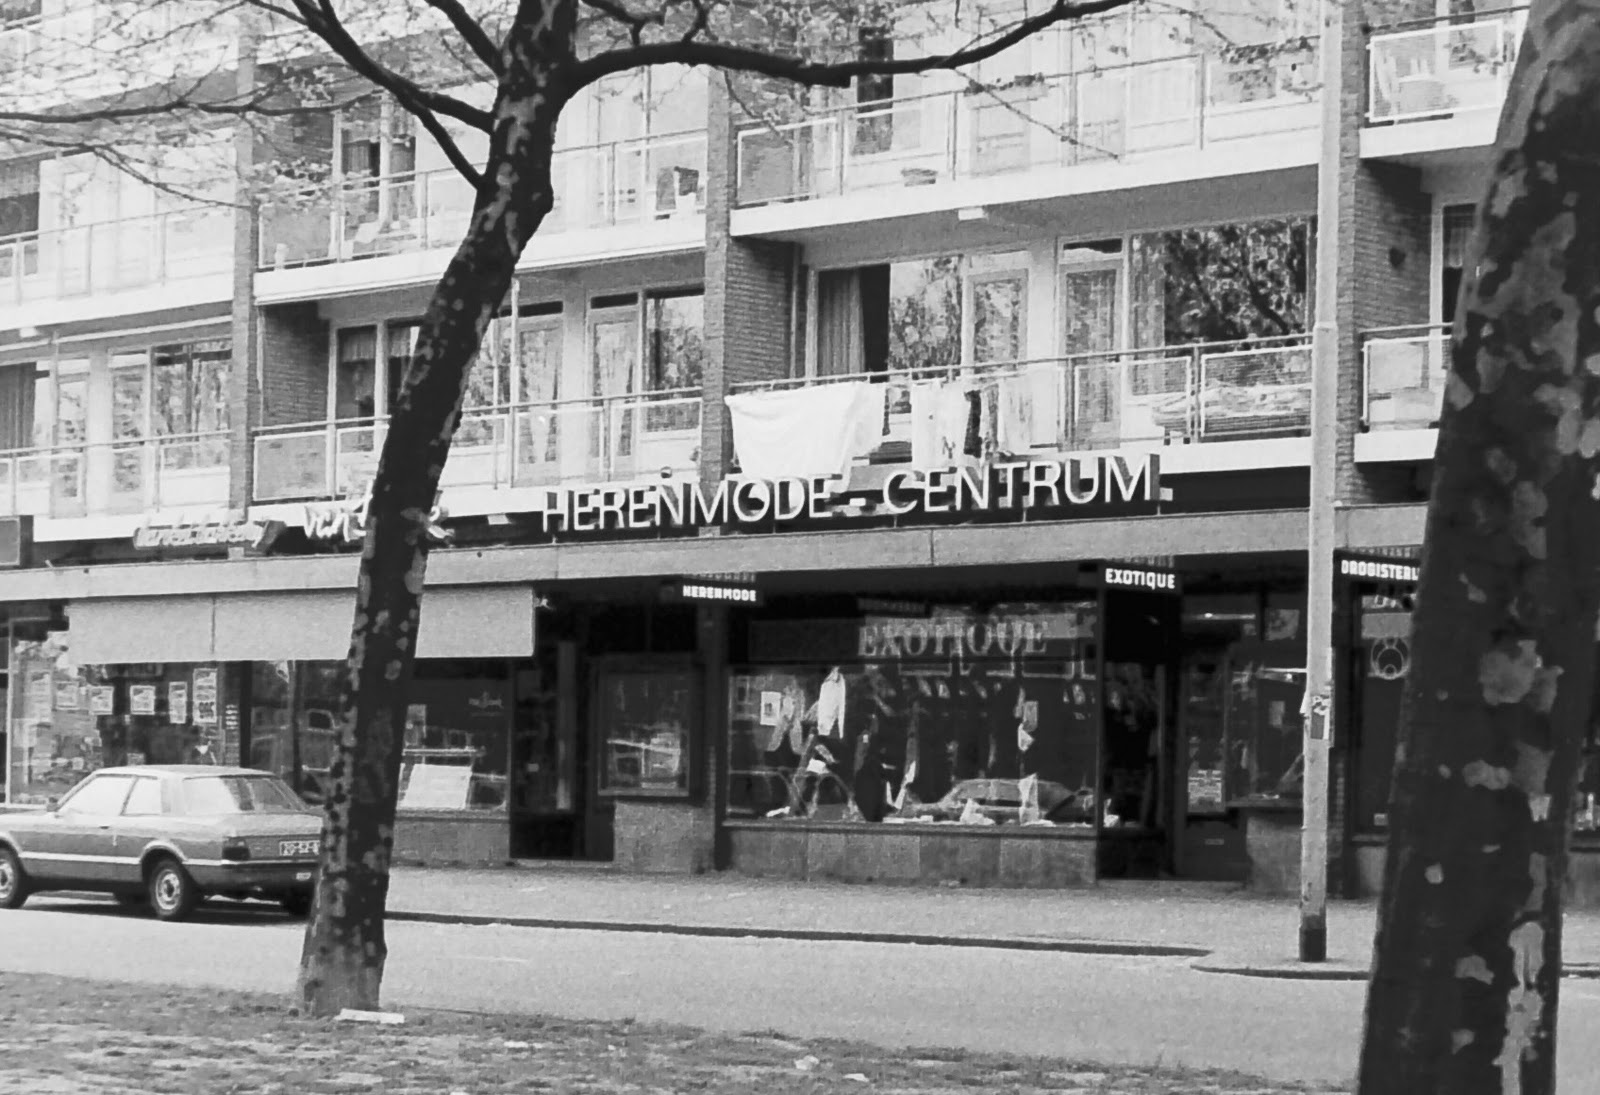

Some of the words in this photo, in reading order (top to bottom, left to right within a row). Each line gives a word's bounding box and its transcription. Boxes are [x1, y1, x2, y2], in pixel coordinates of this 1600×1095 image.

[542, 474, 833, 533] HERENMODE
[882, 452, 1151, 514] CENTRUM
[1105, 567, 1176, 590] EXOTIQUE
[682, 585, 756, 602] HERENMODE
[858, 621, 1048, 657] EXOTIQUE
